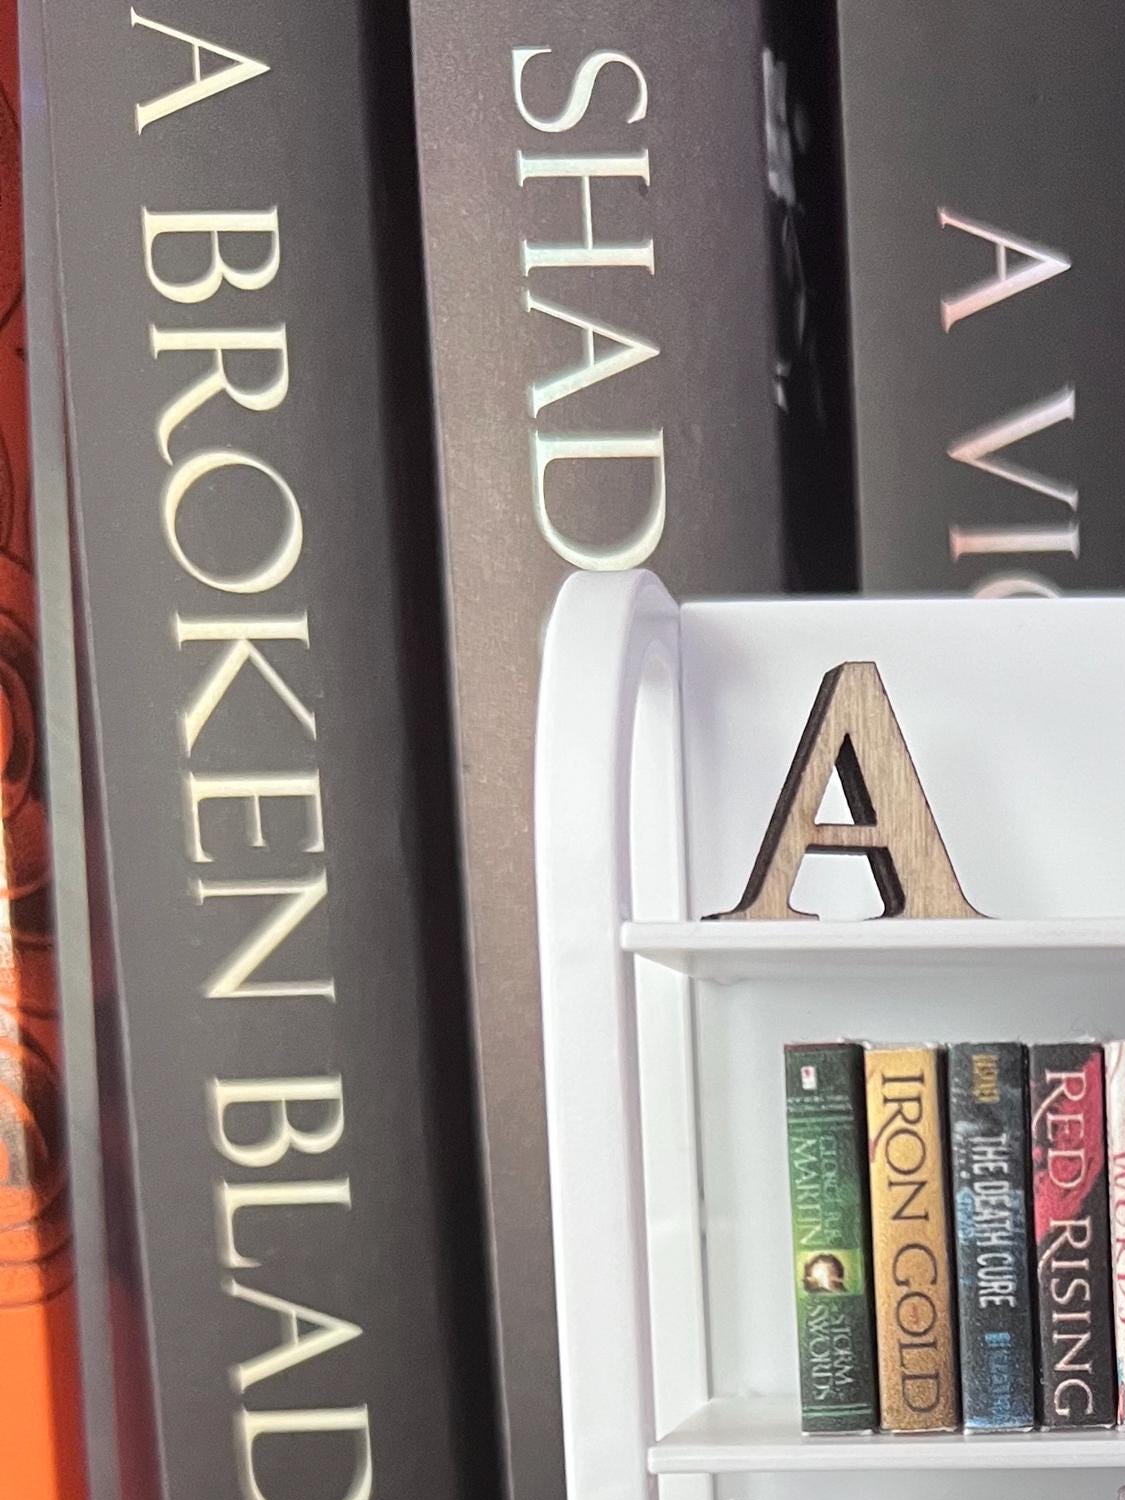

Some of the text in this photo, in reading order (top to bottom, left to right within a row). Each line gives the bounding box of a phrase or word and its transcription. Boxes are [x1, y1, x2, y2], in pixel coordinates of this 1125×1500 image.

[130, 6, 270, 135] A
[511, 46, 667, 572] SHAD
[937, 206, 1082, 598] A VI
[141, 204, 337, 1003] BROKEN
[700, 661, 1000, 920] A
[793, 1137, 823, 1246] MARTIN
[869, 1068, 941, 1414] IRON GOLD
[972, 1133, 1006, 1175] THE
[974, 1182, 1013, 1246] DEATH
[977, 1253, 1016, 1309] CURE
[1032, 1069, 1093, 1417] RED RISING
